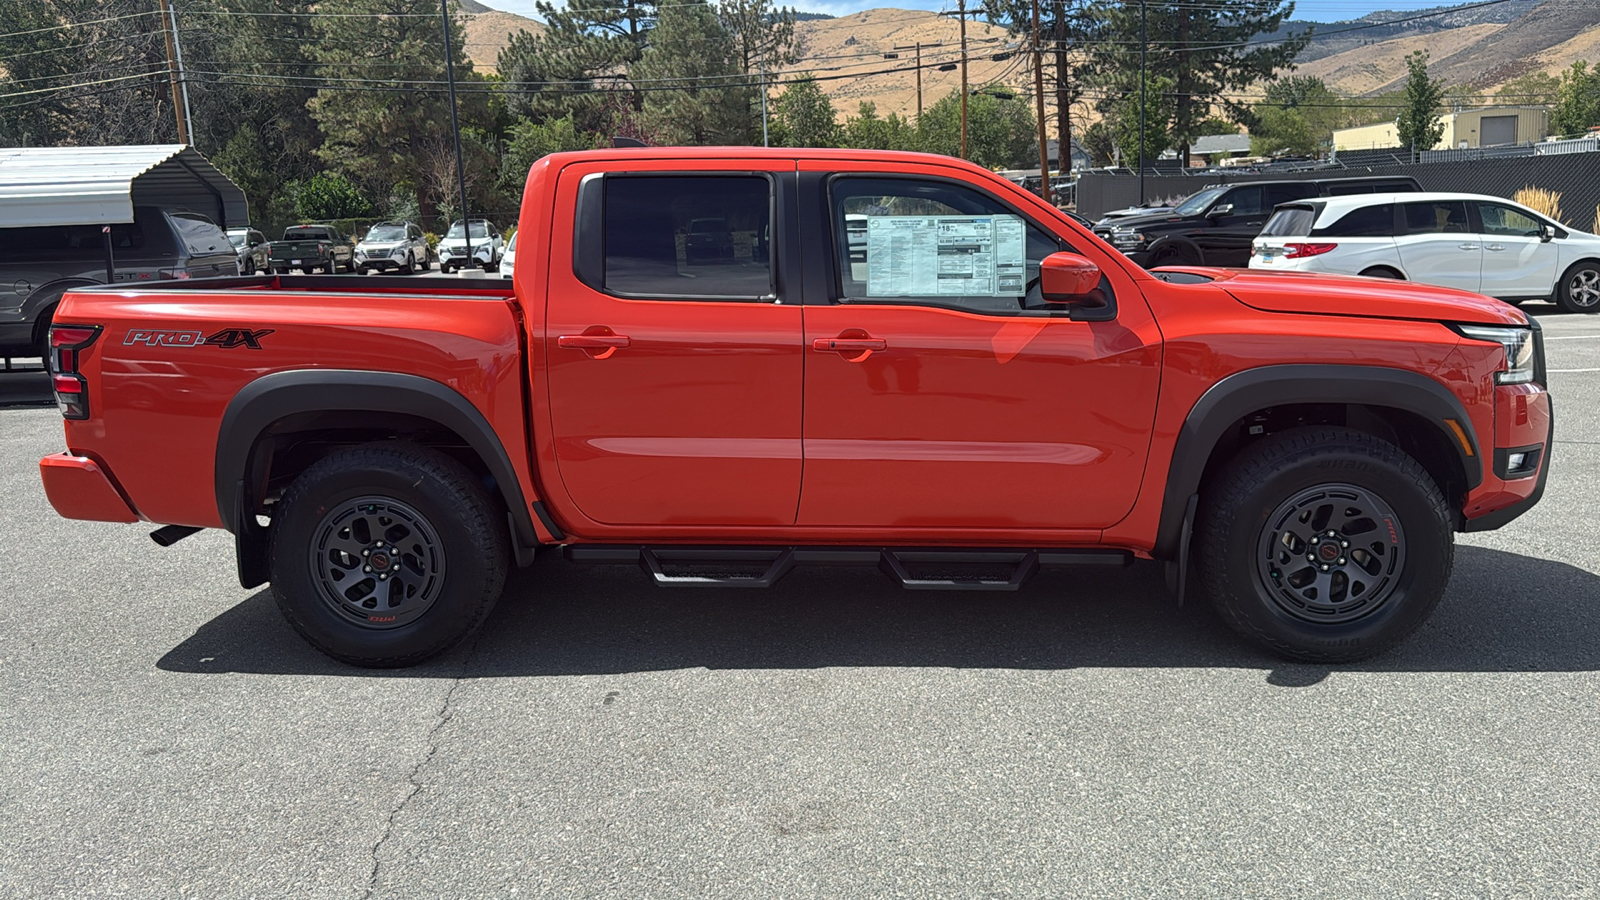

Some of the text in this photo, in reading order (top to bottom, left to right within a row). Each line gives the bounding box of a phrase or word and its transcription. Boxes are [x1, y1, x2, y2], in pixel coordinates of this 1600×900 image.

[114, 272, 152, 280] STX
[122, 328, 276, 350] PRO-4X
[1384, 518, 1398, 544] PRO
